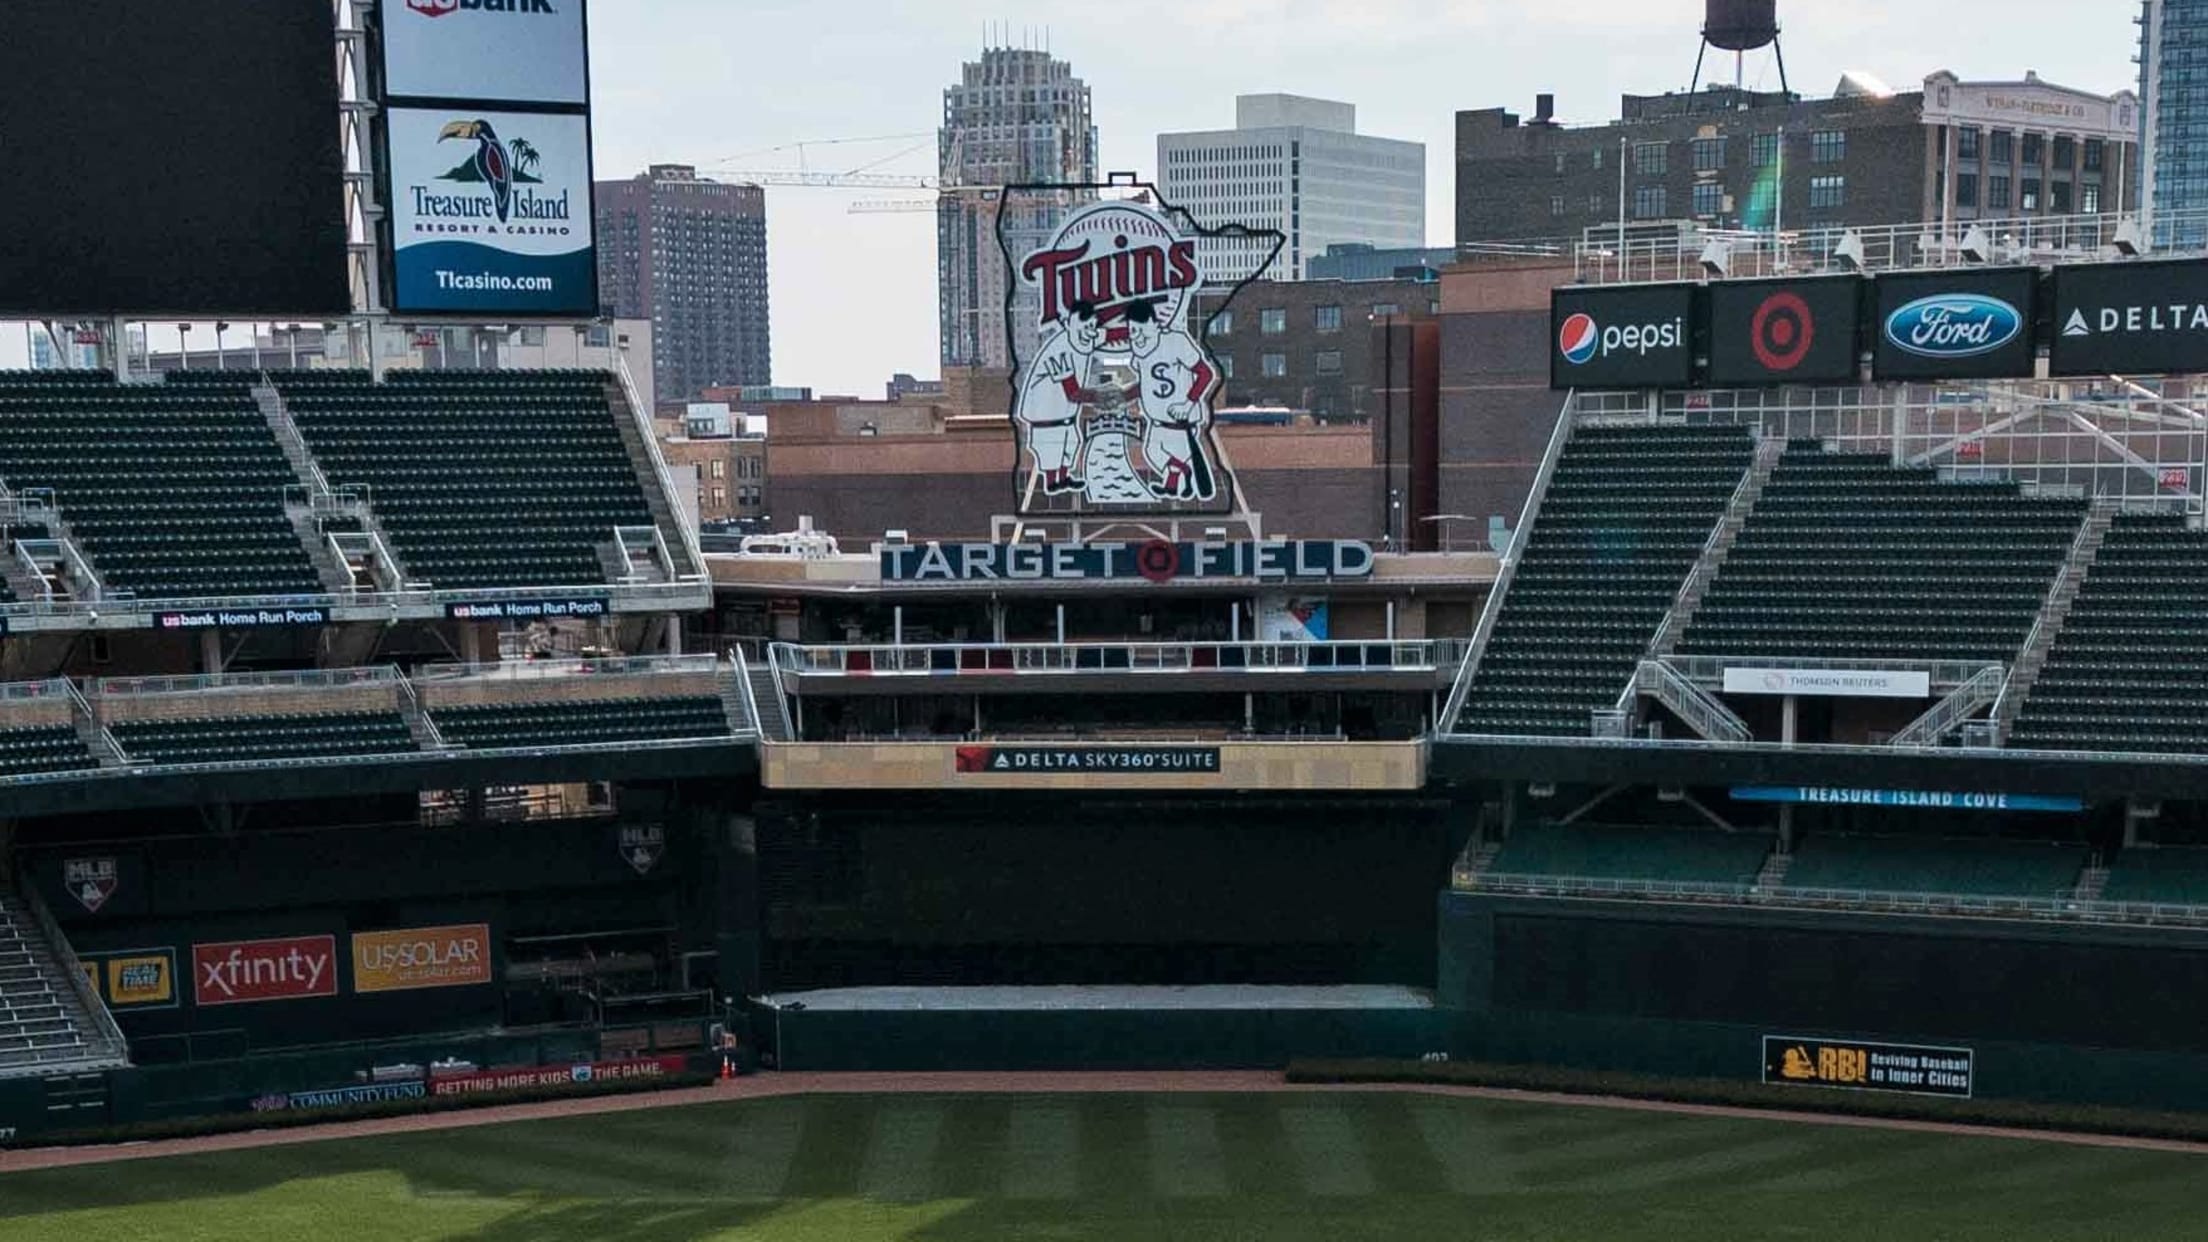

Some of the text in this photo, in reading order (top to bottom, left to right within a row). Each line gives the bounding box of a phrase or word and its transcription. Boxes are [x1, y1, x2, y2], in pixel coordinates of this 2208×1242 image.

[411, 186, 570, 220] Treasure Island
[415, 223, 570, 235] RESORT & CASINO
[435, 269, 552, 291] TIcasino.com
[1022, 234, 1197, 325] Twins
[1911, 304, 1994, 345] Ford
[2100, 303, 2208, 332] DELTA
[1602, 316, 1682, 357] pepsi
[890, 539, 1376, 579] TARGET FIELD
[219, 612, 257, 625] Home
[259, 611, 284, 623] Run
[286, 609, 322, 623] Porch
[506, 603, 541, 615] Home
[543, 602, 566, 614] Run
[568, 600, 602, 613] Porch
[1791, 676, 1888, 688] THOMSON REUTERS
[1015, 754, 1079, 767] DELTA
[1799, 787, 2008, 808] TREASURE ISLAND COVE
[68, 861, 113, 877] MLB
[202, 948, 327, 996] xfinity
[1871, 1053, 1968, 1071] Reviving Baseball
[436, 1077, 494, 1095] GETTING
[497, 1075, 536, 1089] MORE
[539, 1071, 571, 1085] KIDS
[594, 1066, 619, 1080] THE
[1889, 1067, 1925, 1084] Inner
[1928, 1070, 1967, 1088] Cities
[289, 1088, 380, 1109] COMMUNITY
[384, 1085, 426, 1100] FUND
